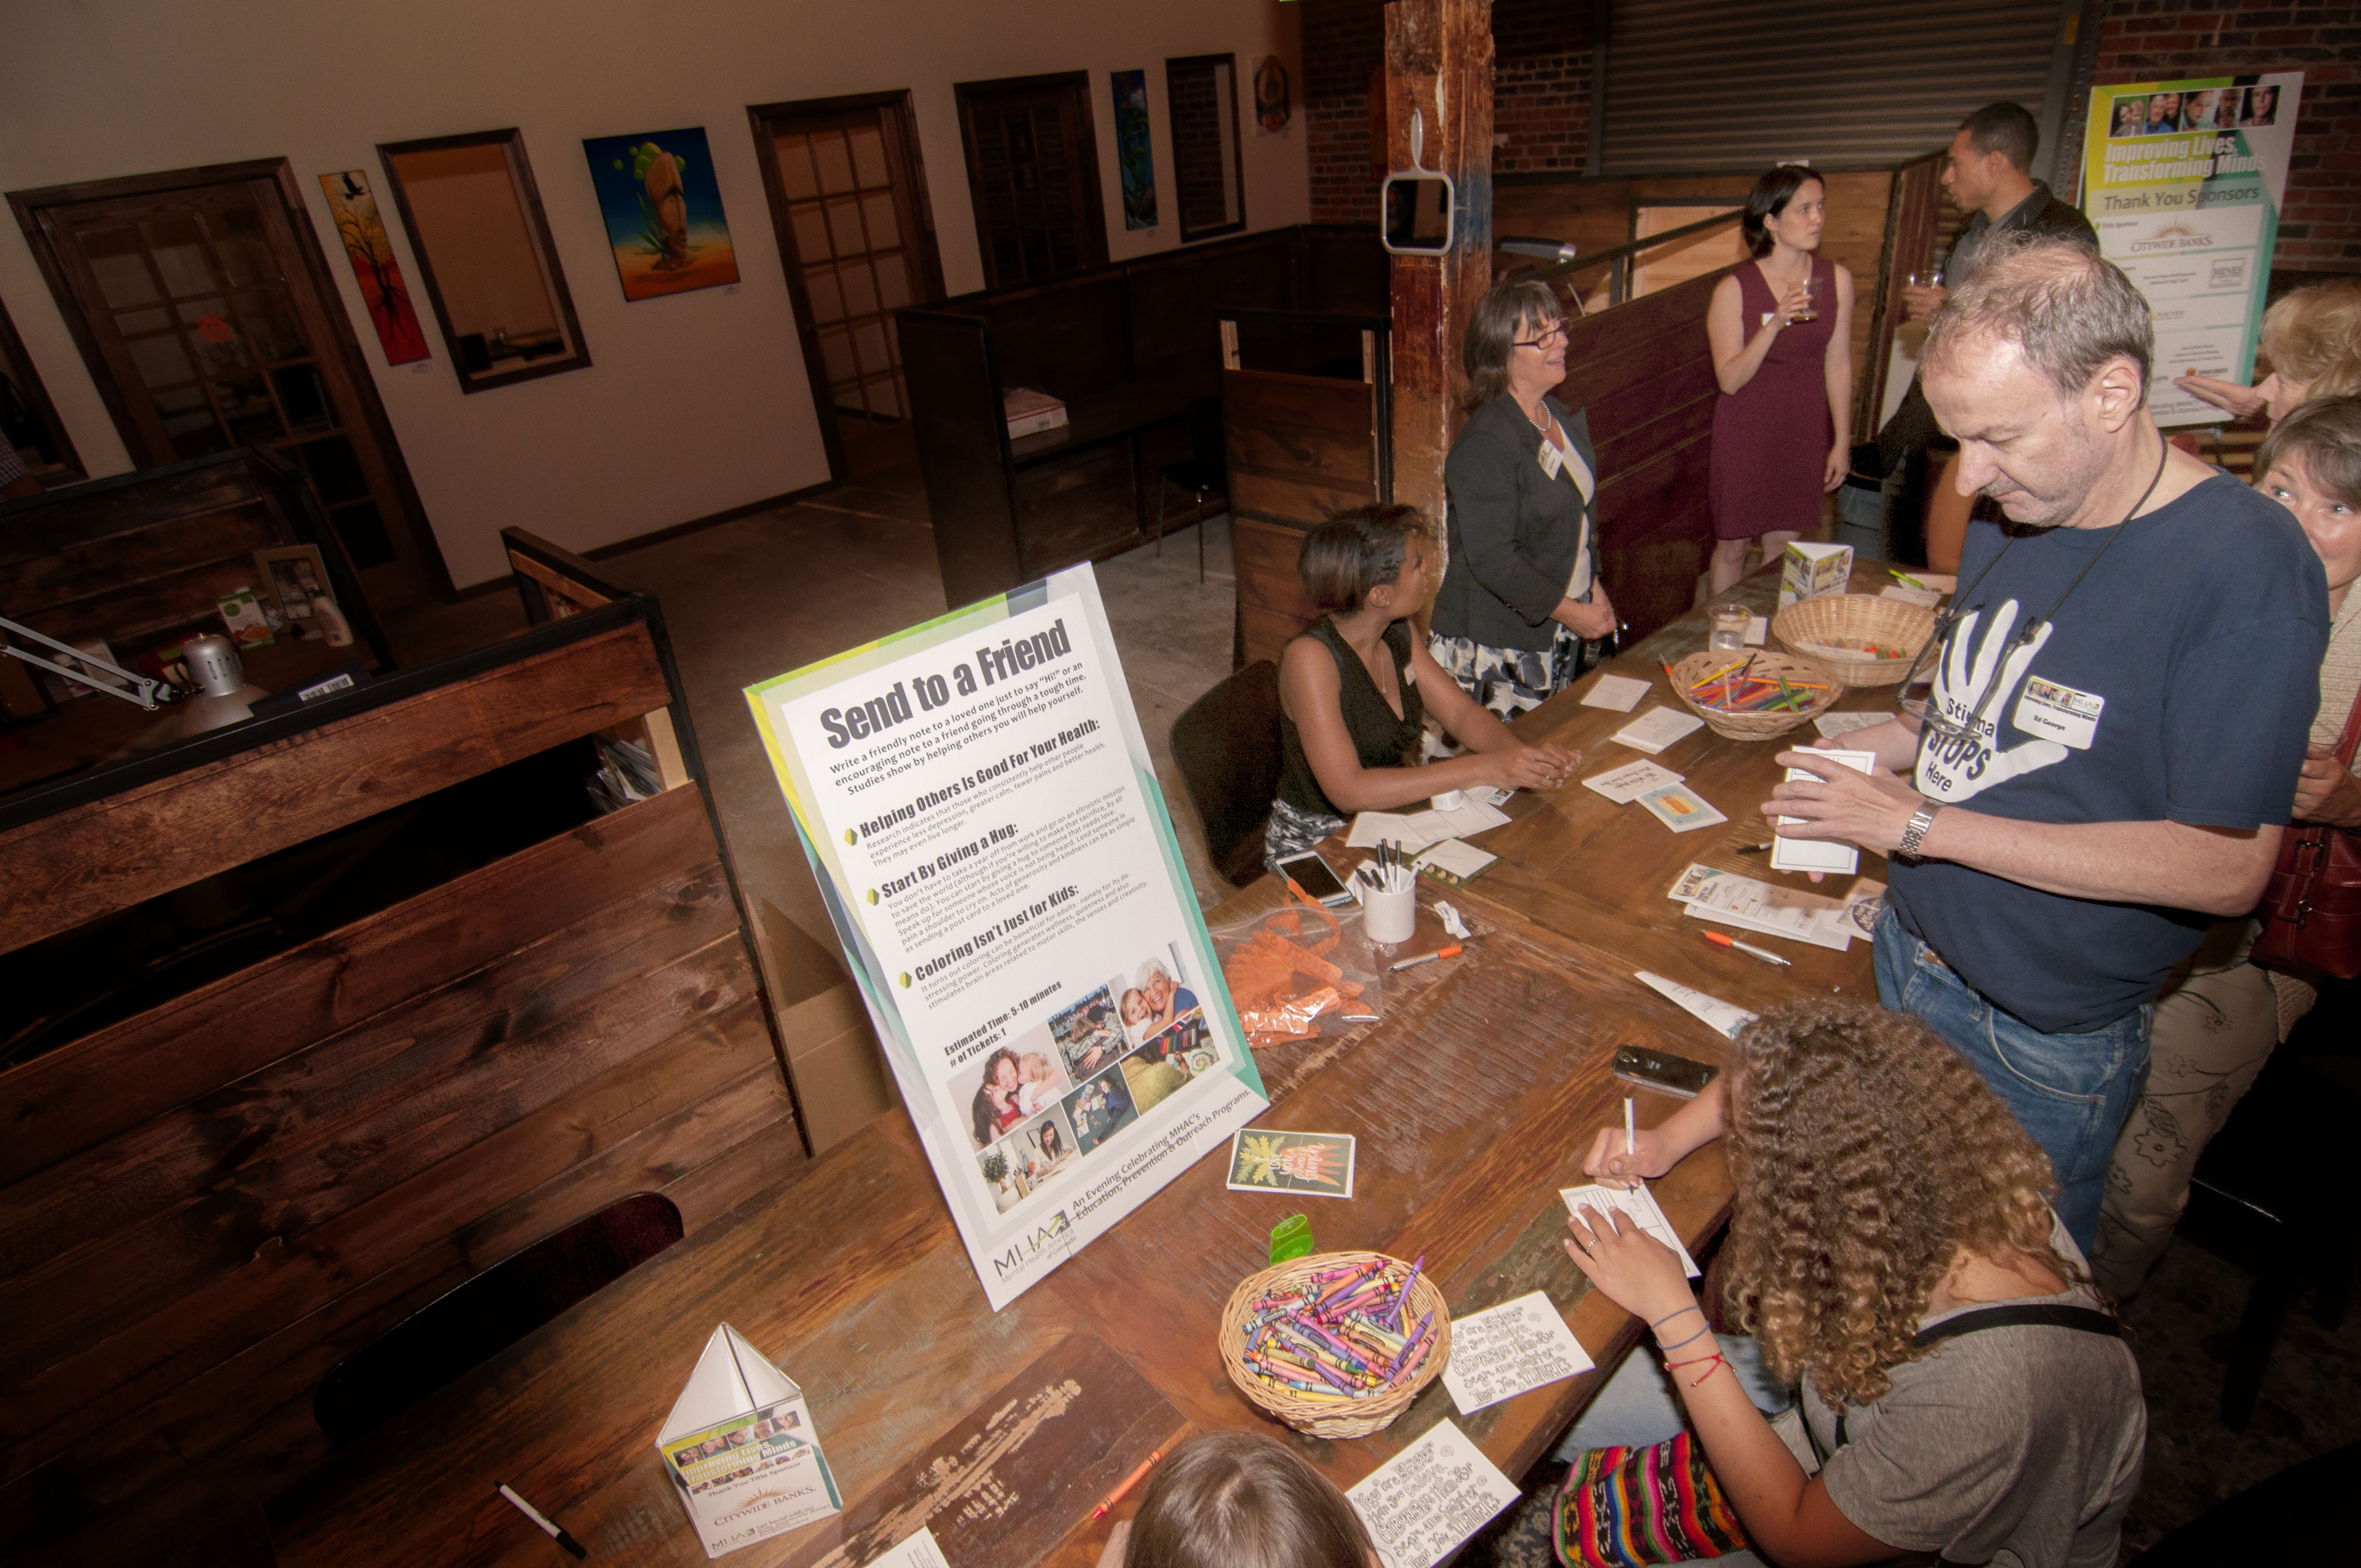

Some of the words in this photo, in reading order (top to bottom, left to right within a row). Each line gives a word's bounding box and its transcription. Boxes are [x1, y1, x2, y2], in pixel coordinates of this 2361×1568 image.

[2103, 157, 2215, 183] Transforming
[2105, 138, 2190, 163] Improving
[2104, 193, 2150, 210] Thank
[2155, 192, 2183, 206] You
[2187, 187, 2260, 209] Sponsors
[819, 680, 915, 750] Send
[911, 673, 951, 712] to
[951, 662, 978, 697] a
[974, 617, 1073, 687] Friend
[829, 756, 860, 774] Write
[860, 753, 868, 762] a
[868, 736, 907, 759] friendly
[908, 726, 932, 742] note
[931, 721, 944, 731] to
[943, 718, 951, 727] a
[950, 704, 977, 723] loved
[977, 699, 995, 712] one
[994, 690, 1014, 706] just
[1013, 687, 1024, 696] to
[1024, 680, 1038, 693] say
[1038, 668, 1060, 684] “Hi!”
[1061, 666, 1071, 676] or
[1071, 661, 1083, 672] an
[834, 753, 899, 787] encouraging
[897, 744, 922, 760] note
[921, 739, 933, 749] to
[933, 736, 941, 744] a
[940, 721, 970, 741] friend
[970, 710, 998, 731] going
[996, 694, 1033, 716] through
[1032, 693, 1040, 701] a
[1038, 680, 1065, 698] tough
[1064, 673, 1087, 687] time.
[2033, 715, 2042, 723] Ed
[2042, 718, 2066, 731] George
[846, 773, 885, 796] Studies
[885, 761, 912, 779] show
[911, 755, 925, 767] by
[924, 738, 963, 761] helping
[962, 726, 993, 745] others
[992, 718, 1010, 734] you
[1009, 709, 1027, 723] will
[1026, 702, 1047, 716] help
[1046, 684, 1084, 710] yourself.
[858, 803, 917, 839] Helping
[915, 782, 962, 812] Others
[960, 775, 976, 792] Is
[975, 757, 1010, 785] Good
[1008, 749, 1030, 770] For
[1028, 737, 1058, 759] Your
[1057, 718, 1101, 747] Health:
[865, 829, 902, 851] Research
[900, 813, 936, 834] indicates
[934, 805, 952, 818] that
[950, 796, 972, 810] those
[971, 788, 988, 801] who
[987, 769, 1029, 793] consistently
[1027, 761, 1044, 774] help
[1043, 753, 1062, 767] other
[1061, 743, 1085, 760] people
[1925, 761, 1952, 792] Here
[871, 854, 892, 868] They
[891, 846, 909, 859] may
[908, 837, 928, 851] even
[926, 830, 942, 842] live
[940, 819, 968, 835] longer.
[880, 870, 919, 899] Start
[916, 862, 937, 881] By
[935, 840, 980, 872] Giving
[978, 836, 990, 850] a
[987, 823, 1019, 845] Hug:
[913, 940, 974, 982] Coloring
[971, 923, 1004, 950] Isn't
[1002, 908, 1031, 934] Just
[1028, 899, 1048, 919] for
[1047, 884, 1080, 908] Kids:
[943, 1023, 988, 1057] Estimated
[986, 1011, 1012, 1031] Time:
[1009, 998, 1030, 1017] 5-10
[1028, 980, 1063, 1006] minutes
[949, 1057, 958, 1069] #
[956, 1050, 968, 1064] of
[965, 1032, 1002, 1058] Tickets:
[999, 1026, 1007, 1037] 1
[1072, 1197, 1085, 1211] An
[1085, 1170, 1123, 1200] Evening
[1120, 1135, 1170, 1174] Celebrating
[1168, 1113, 1200, 1140] MHAC's
[1075, 1180, 1123, 1221] Education,
[1121, 1148, 1168, 1186] Prevention
[1166, 1142, 1176, 1153] &
[1175, 1115, 1212, 1146] Outreach
[1211, 1088, 1251, 1120] Programs.
[1270, 1152, 1283, 1170] LOVE
[1000, 1262, 1025, 1284] Mental
[1024, 1248, 1047, 1267] Health
[1047, 1228, 1074, 1251] America
[1046, 1251, 1053, 1260] of
[1052, 1235, 1077, 1255] Colorado
[1262, 1308, 1287, 1325] Crayola
[680, 1451, 739, 1478] Improving
[762, 1439, 797, 1458] Minds
[708, 1485, 733, 1498] Thank
[733, 1480, 749, 1491] You
[750, 1473, 768, 1483] Title
[769, 1461, 803, 1476] Sponsor
[714, 1501, 771, 1526] CITYWIDE
[756, 1521, 768, 1530] Get
[768, 1515, 788, 1527] Social
[788, 1510, 804, 1520] with
